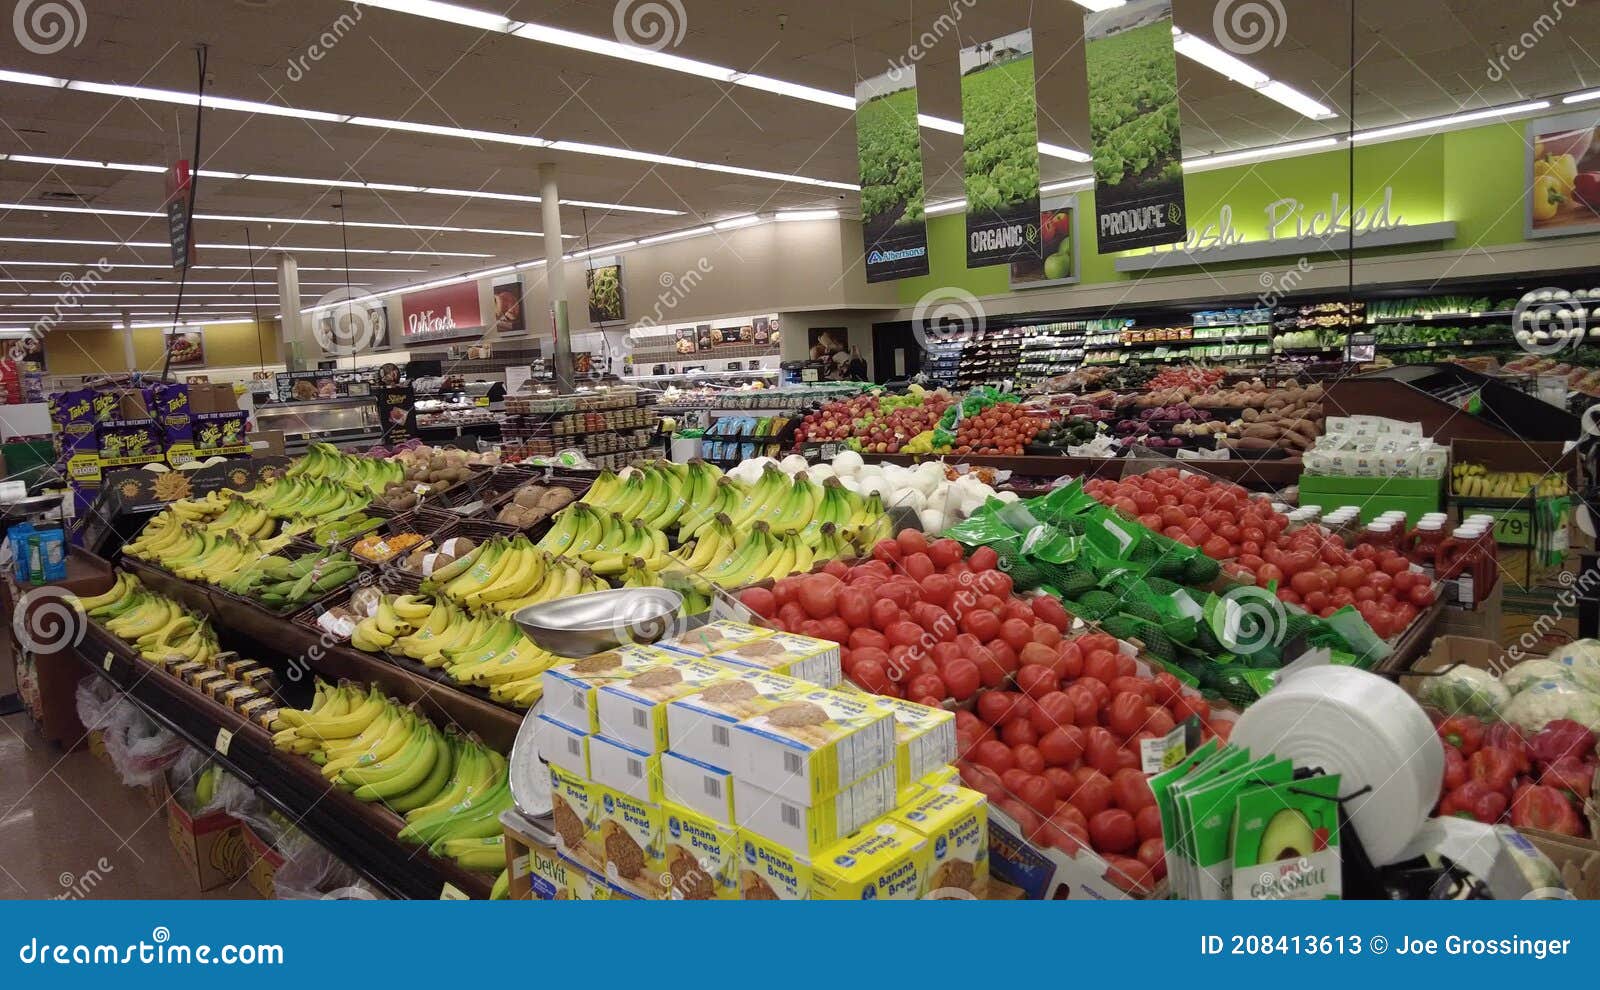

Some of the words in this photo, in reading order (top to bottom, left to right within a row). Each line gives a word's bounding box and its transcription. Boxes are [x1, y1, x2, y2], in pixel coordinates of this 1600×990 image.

[1100, 204, 1165, 237] PRODUCE
[1265, 187, 1407, 241] Picked
[970, 225, 1023, 253] ORGANIC
[881, 246, 925, 263] Albertsons
[67, 399, 91, 420] Takis
[168, 393, 188, 412] Takis
[223, 419, 241, 434] akis
[566, 786, 588, 802] Bread
[616, 797, 646, 816] Banana
[623, 811, 650, 828] Bread
[948, 815, 977, 840] Banana
[682, 820, 717, 842] Banana
[956, 824, 980, 848] Bread
[691, 836, 721, 856] Bread
[534, 849, 568, 885] belVit
[758, 847, 794, 872] Banana
[767, 866, 797, 887] Bread
[879, 861, 914, 888] Banana
[888, 869, 918, 896] Bread
